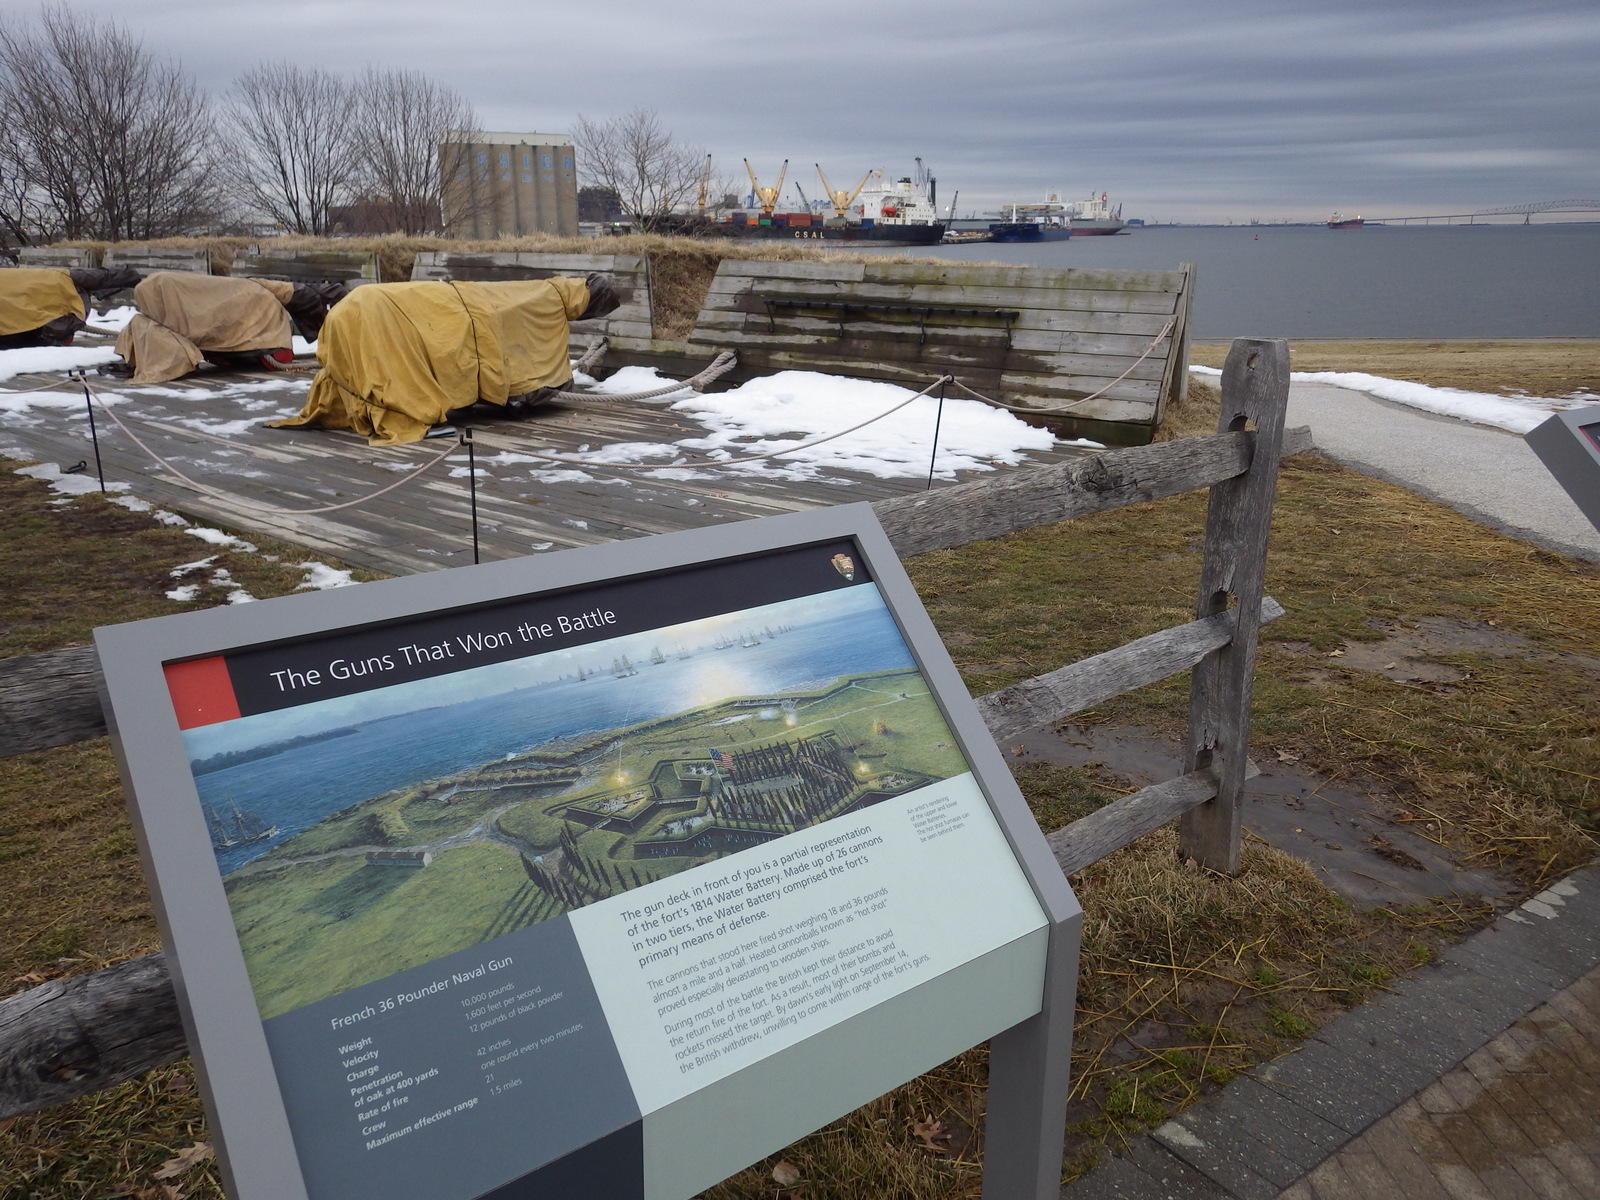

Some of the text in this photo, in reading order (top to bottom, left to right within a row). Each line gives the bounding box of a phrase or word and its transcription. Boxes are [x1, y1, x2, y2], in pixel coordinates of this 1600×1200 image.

[794, 230, 825, 239] CSAL
[269, 607, 617, 692] The Guns That Won the Battle
[619, 825, 872, 922] The gun deck in front of you is a partial representation
[627, 835, 884, 937] of the fort's 1814 Water Battery. Made up of 26 cannons
[631, 855, 869, 952] in two tiers, the Water Battery comprised the fort's
[638, 910, 770, 970] primary means of defense.
[646, 886, 889, 991] The cannons that stood here fired shot weighing 18 and 36 pounds
[652, 985, 682, 1004] almost
[681, 983, 689, 992] a
[688, 974, 707, 989] mile
[707, 966, 724, 981] and
[724, 965, 731, 974] a
[730, 956, 749, 971] half.
[748, 944, 777, 963] Heated
[777, 927, 820, 952] cannonballs
[818, 918, 845, 934] known
[845, 914, 855, 924] as
[330, 956, 513, 1030] French 36 Pounder Naval Gun
[461, 982, 515, 1008] 10,000 pounds
[657, 938, 830, 1019] proved especially devastating to wooden ships.
[663, 927, 894, 1035] During most of the battle the British kept their distance to avoid
[669, 940, 896, 1048] the return fire of the fort. As a result, most of their bombs and
[465, 984, 542, 1021] 1,600 feet per second
[469, 991, 563, 1033] 12 pounds of black powder
[674, 949, 910, 1061] rockets missed the target. By dawn's early light on September 14,
[338, 1036, 373, 1055] Weight
[341, 1049, 379, 1069] Velocity
[476, 1038, 512, 1057] 42 inches
[480, 1023, 584, 1070] one round every two minutes
[346, 1064, 380, 1082] Charge
[350, 1070, 404, 1097] Penetration
[354, 1067, 439, 1108] of oak at 400 yards
[484, 1073, 495, 1084] 21
[489, 1077, 523, 1096] 1.5 miles
[357, 1096, 409, 1122] Rate of fire
[361, 1120, 387, 1136] Crew
[366, 1097, 479, 1151] Maximum effective range
